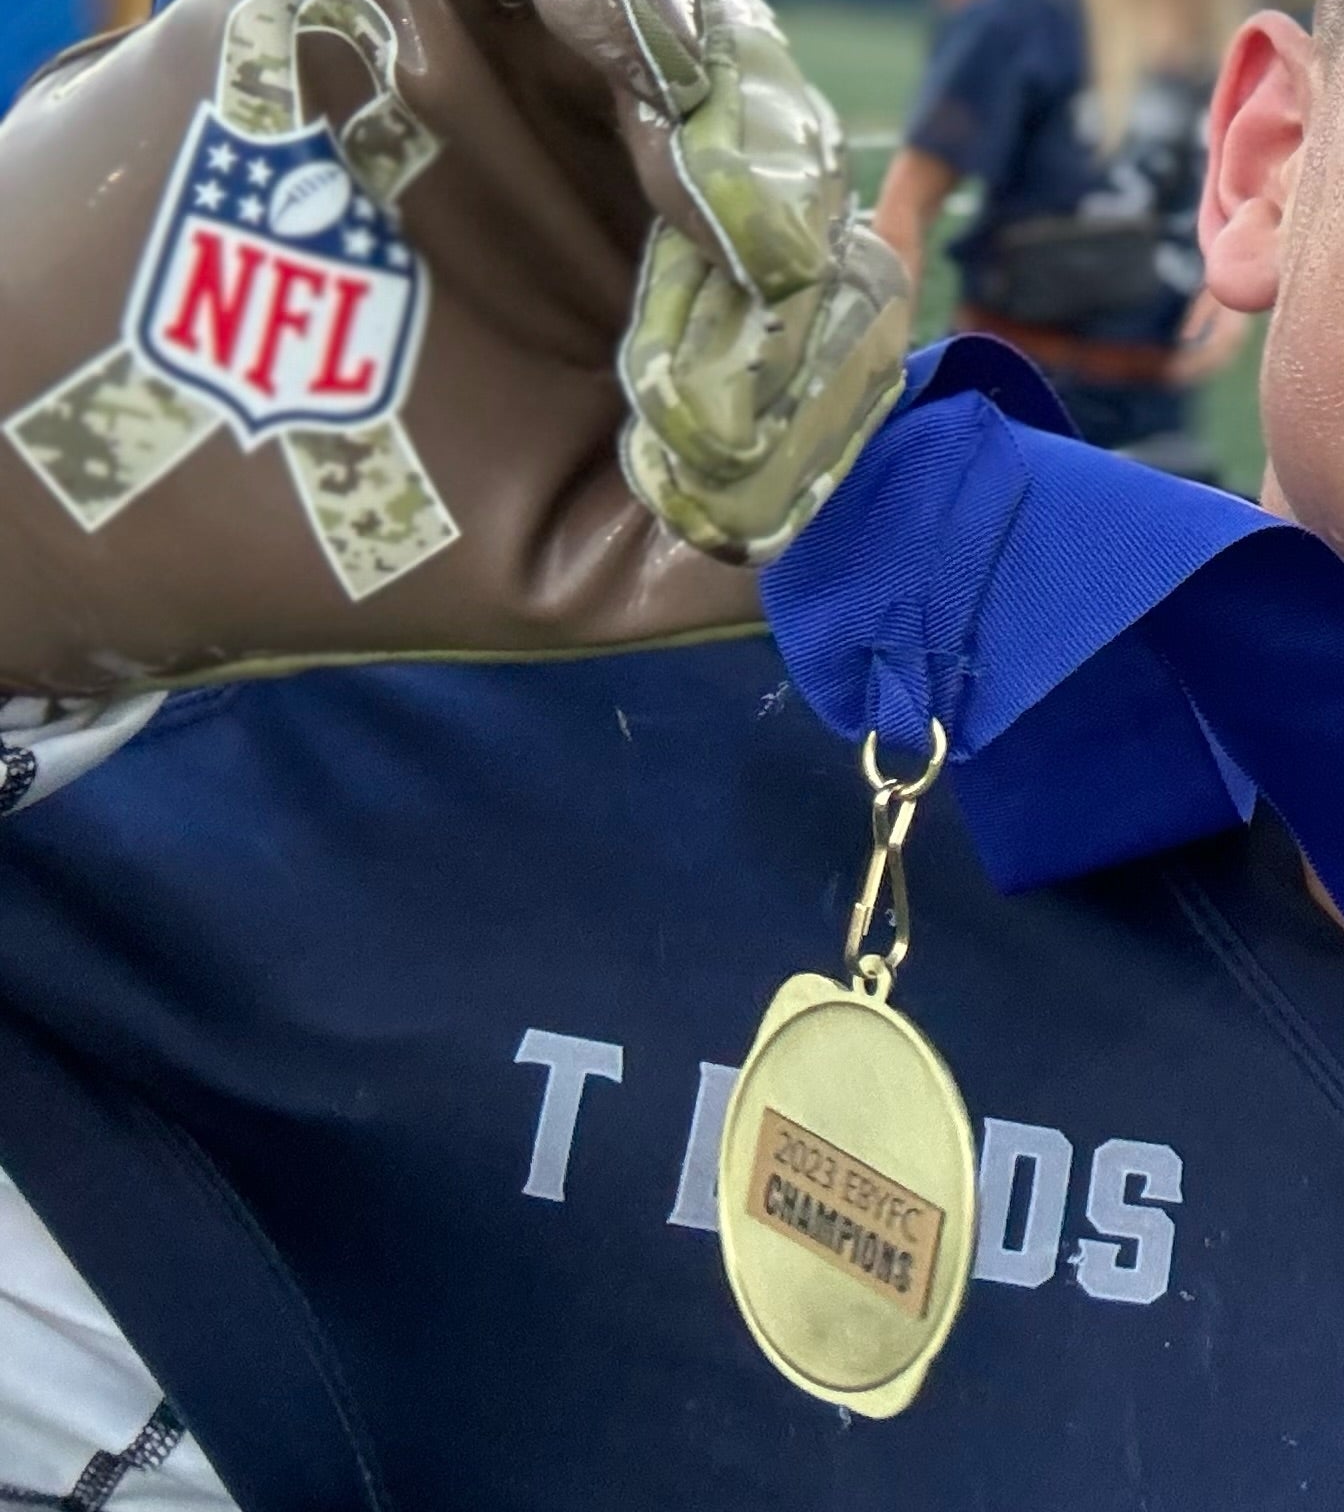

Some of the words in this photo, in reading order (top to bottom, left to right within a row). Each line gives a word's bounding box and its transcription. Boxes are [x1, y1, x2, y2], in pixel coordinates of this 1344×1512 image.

[163, 229, 377, 397] NFL
[773, 1129, 836, 1190] 2023
[764, 1174, 913, 1293] CHAMPIONS
